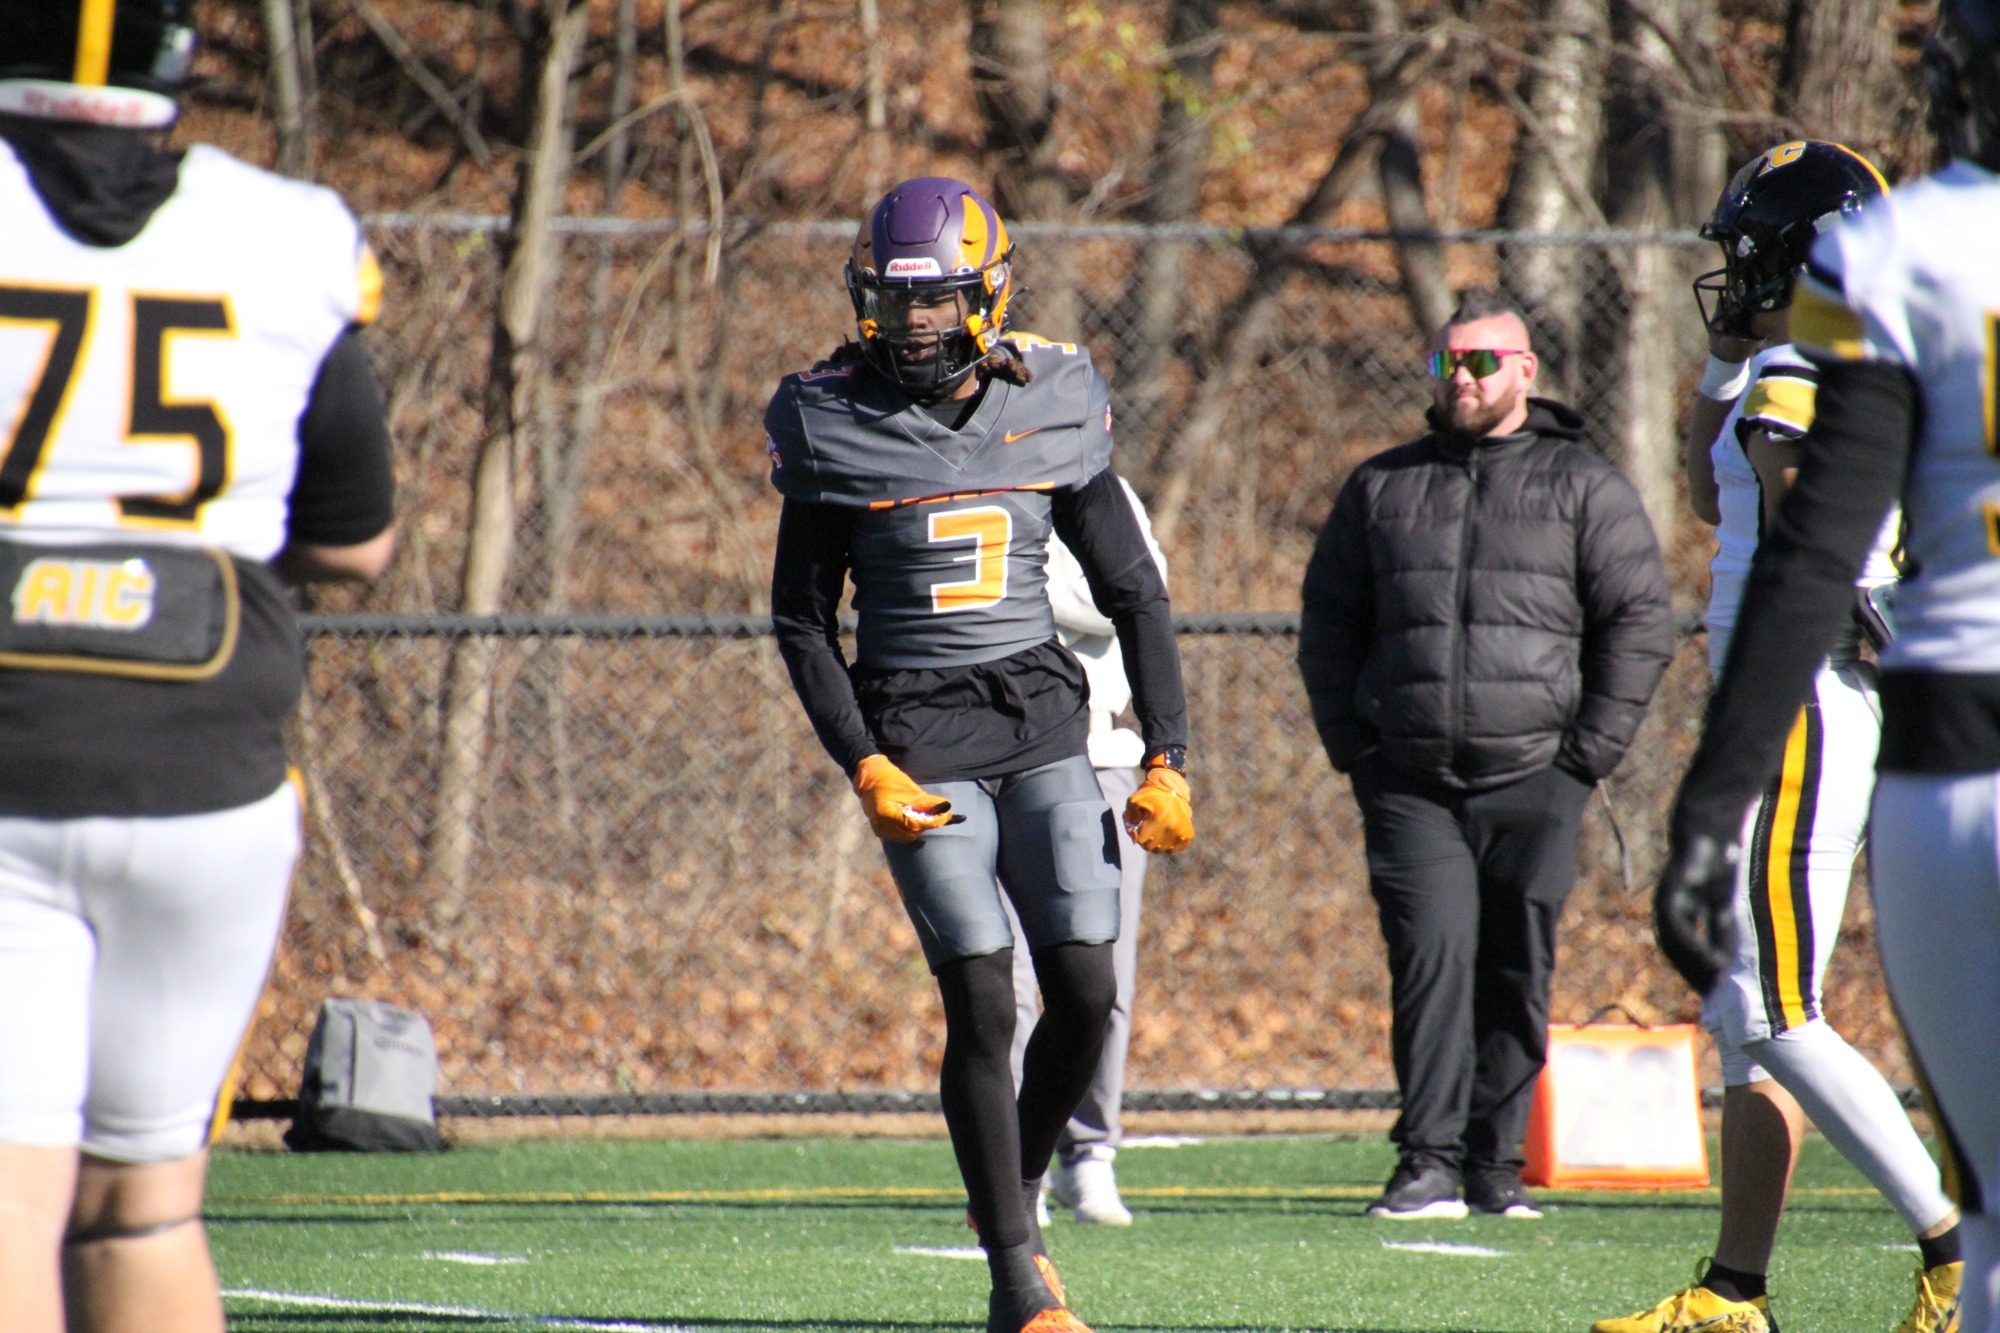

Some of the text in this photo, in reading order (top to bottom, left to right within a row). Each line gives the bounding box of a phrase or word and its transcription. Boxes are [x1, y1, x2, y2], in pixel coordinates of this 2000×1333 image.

[889, 261, 932, 272] Riddell
[0, 279, 239, 532] 75
[12, 557, 155, 631] AIC
[928, 505, 1012, 613] 3
